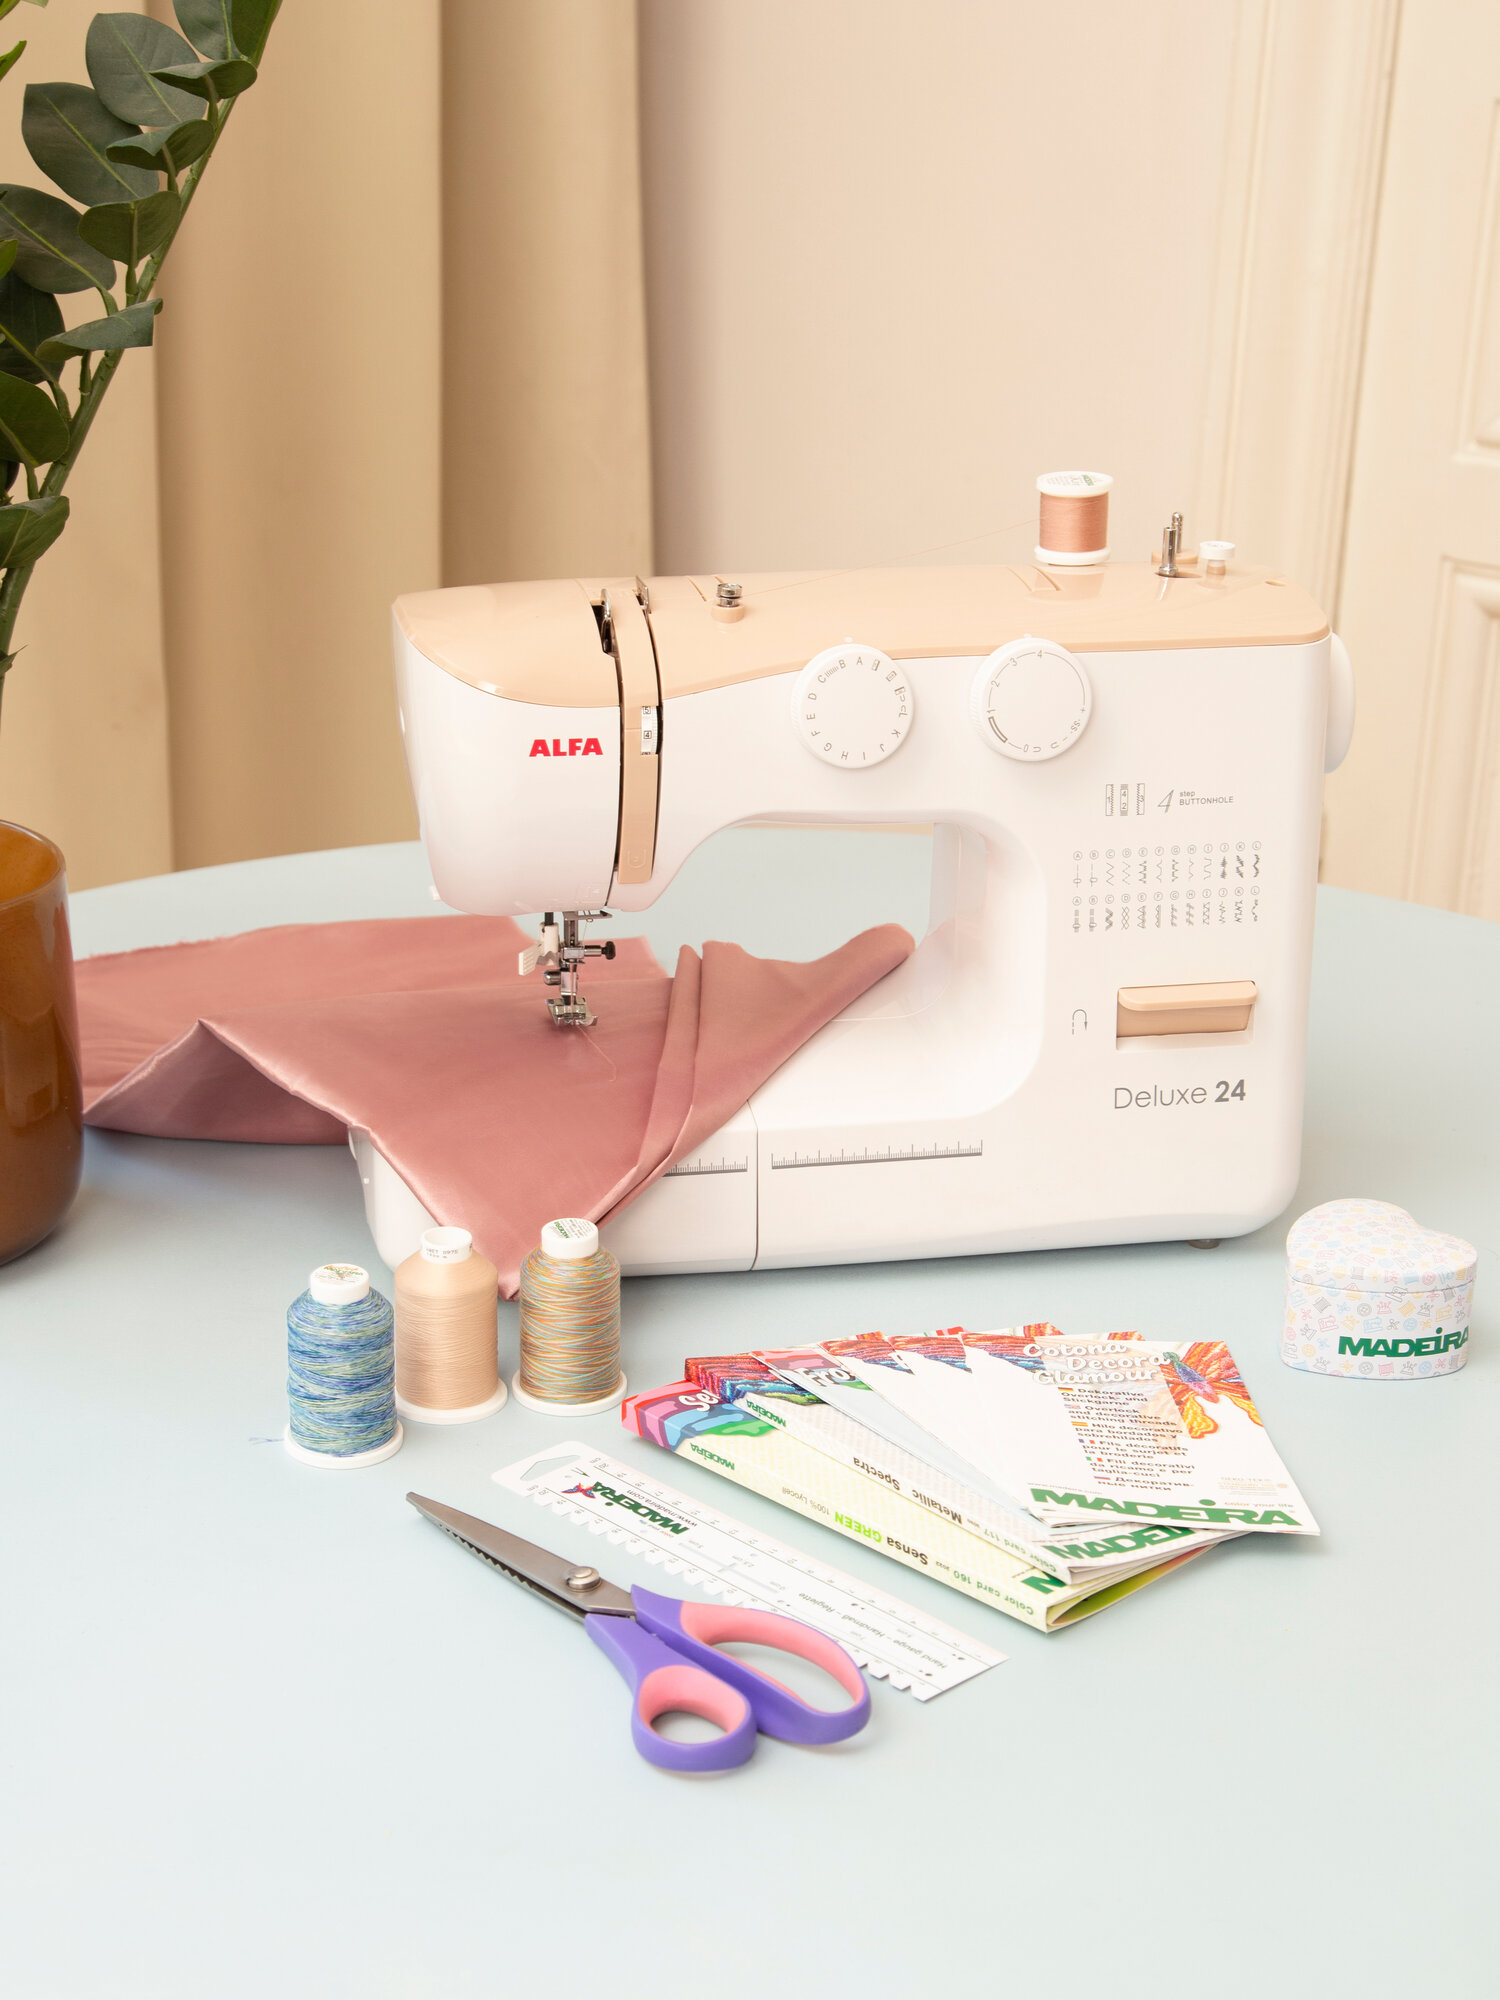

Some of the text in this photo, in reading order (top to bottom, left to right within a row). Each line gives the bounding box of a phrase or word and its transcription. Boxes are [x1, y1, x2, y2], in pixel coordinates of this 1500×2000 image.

[1037, 650, 1042, 658] 4
[839, 660, 846, 669] B
[856, 656, 863, 665] A
[1010, 658, 1018, 666] 3
[818, 675, 826, 683] C
[991, 680, 1000, 688] 2
[808, 692, 817, 700] D
[891, 729, 901, 738] K
[529, 738, 603, 757] ALFA
[824, 742, 832, 752] G
[880, 744, 885, 752] J
[1024, 744, 1029, 752] 0
[841, 751, 848, 760] H
[1157, 789, 1175, 813] 4
[1180, 796, 1234, 805] BUTTONHOLE
[1114, 1079, 1246, 1109] Deluxe 24
[1023, 1342, 1127, 1358] Cotona
[1067, 1354, 1170, 1371] Decora
[1033, 1369, 1158, 1385] Glamour
[1078, 1388, 1144, 1397] Dekorative
[1064, 1397, 1129, 1406] Stickgarne
[1070, 1415, 1177, 1426] stitching threads
[1096, 1412, 1161, 1420] decorative
[1107, 1429, 1162, 1438] bordados
[1119, 1425, 1183, 1434] decorativo
[1078, 1433, 1158, 1442] sobrehilados
[1100, 1451, 1155, 1459] broderie
[1110, 1464, 1154, 1472] ricamo
[1131, 1460, 1195, 1469] decorativi
[853, 1457, 900, 1491] Spectra
[1092, 1468, 1160, 1477] taglia-cuci
[782, 1486, 807, 1504] Lyocell
[627, 1489, 698, 1527] www.madeira.com
[810, 1497, 829, 1515] 100%
[912, 1489, 963, 1525] Metallic
[835, 1511, 882, 1543] GREEN
[887, 1536, 928, 1565] Sensa
[1004, 1539, 1026, 1554] card
[1030, 1553, 1057, 1573] Color
[954, 1570, 972, 1585] 160
[976, 1580, 1000, 1597] card
[1005, 1596, 1034, 1615] Color
[893, 1638, 918, 1651] gauge
[922, 1655, 948, 1669] Hand
